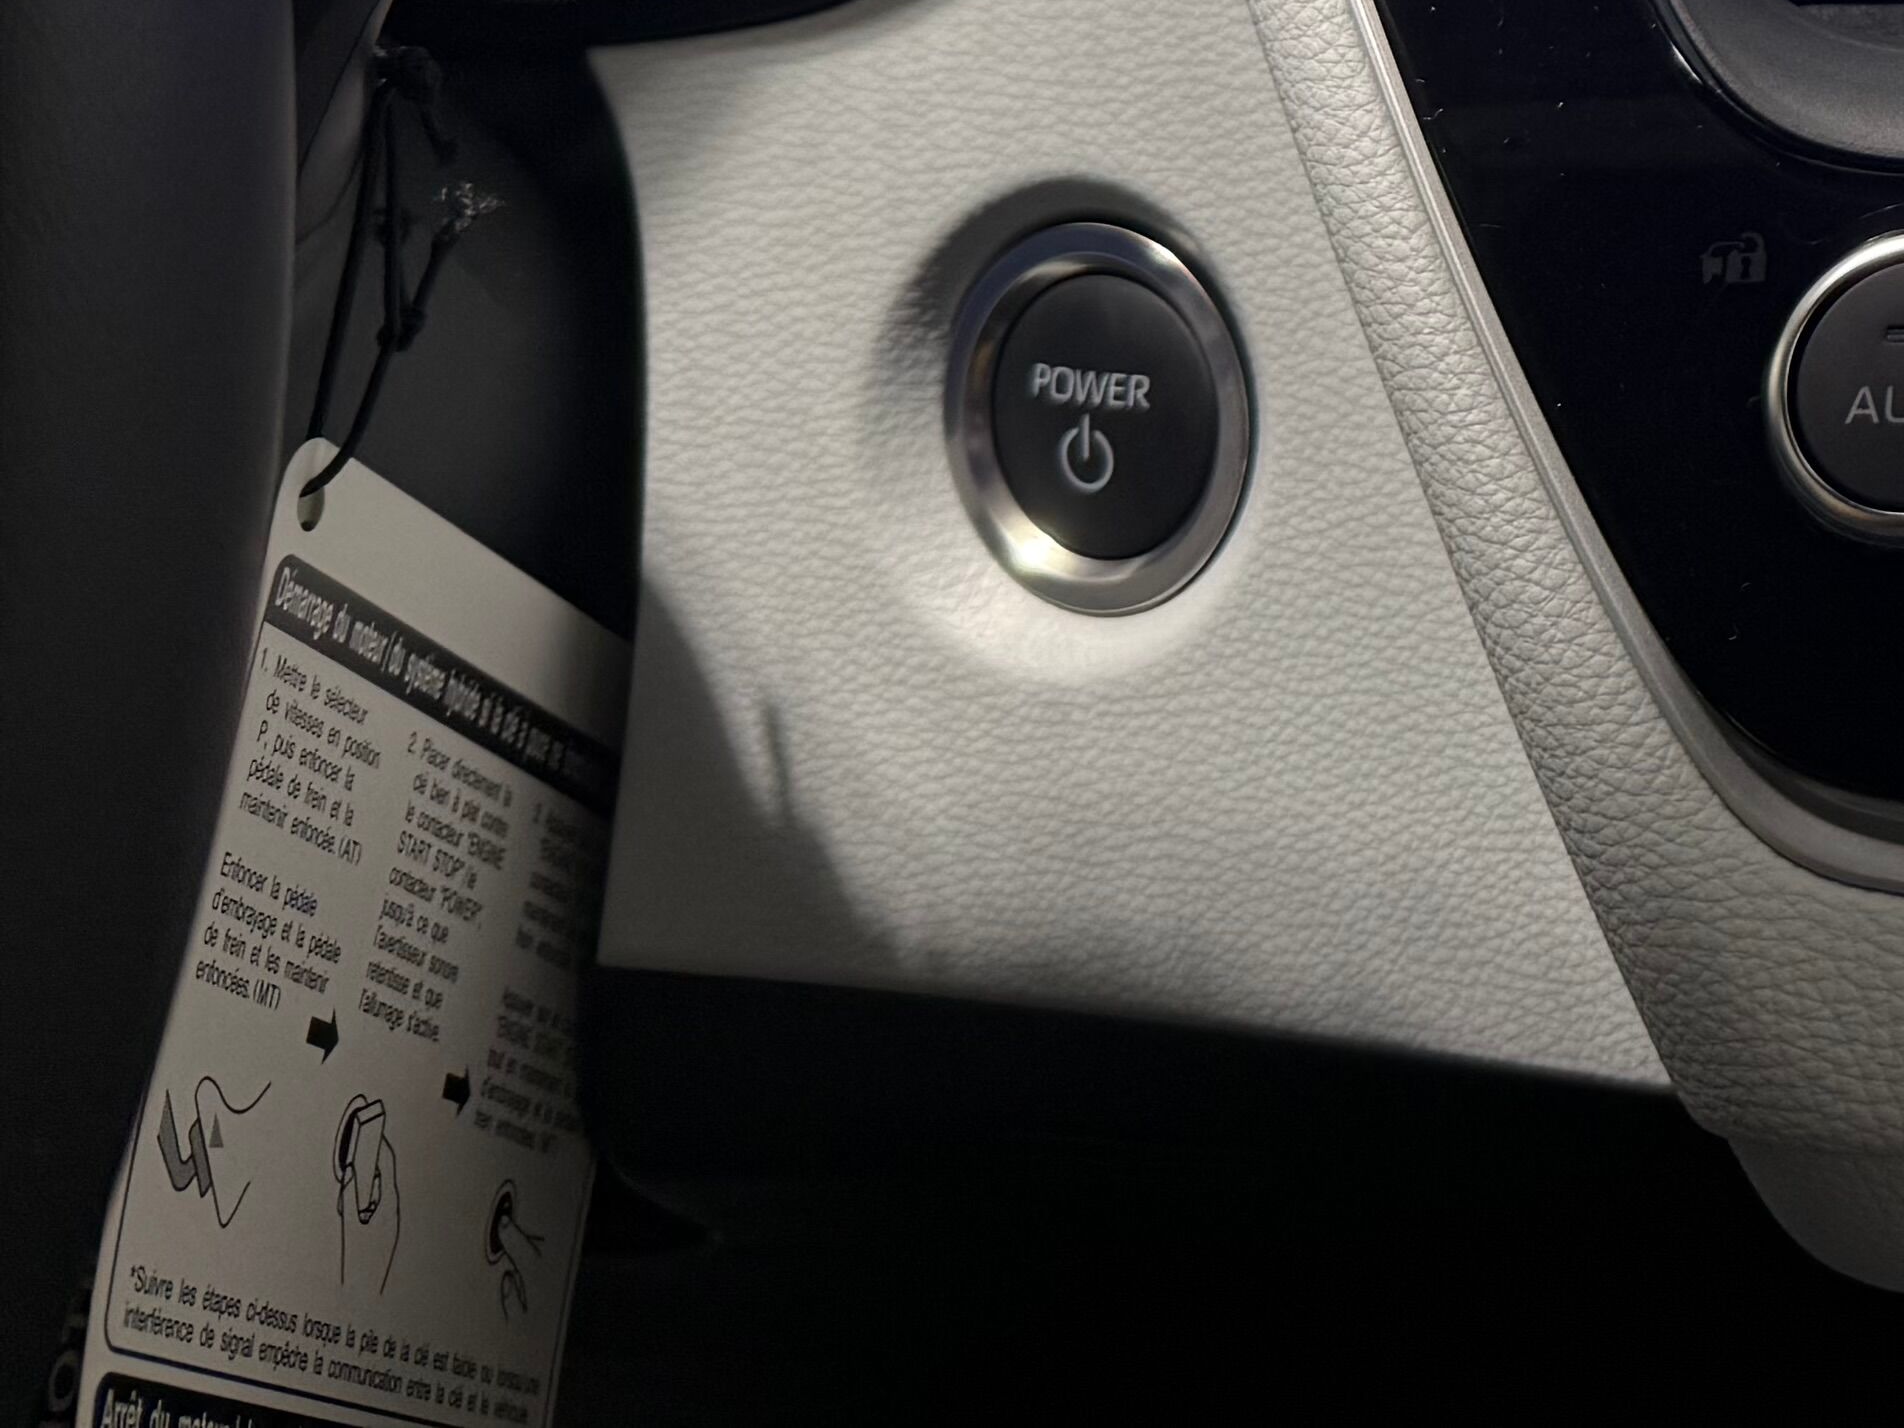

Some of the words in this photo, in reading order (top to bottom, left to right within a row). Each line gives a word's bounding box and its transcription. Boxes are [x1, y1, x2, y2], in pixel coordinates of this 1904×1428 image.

[1031, 361, 1150, 411] POWER
[276, 565, 333, 641] Démarrage
[333, 602, 352, 644] du
[260, 647, 269, 673] 1.
[273, 653, 308, 693] Mettre
[310, 674, 321, 701] le
[324, 685, 368, 726] sélecteur
[265, 688, 281, 715] de
[285, 699, 325, 739] vitesses
[327, 726, 342, 748] en
[342, 735, 380, 770] position
[270, 733, 297, 760] puis
[299, 747, 343, 784] enfoncer
[343, 764, 356, 793] la
[247, 755, 284, 791] pédale
[286, 773, 301, 800] de
[303, 780, 327, 813] frein
[329, 799, 343, 821] et
[342, 802, 355, 828] la
[239, 791, 289, 829] maintenir
[338, 833, 362, 867] (AT)
[397, 830, 433, 867] START
[219, 850, 268, 893] Enfoncer
[269, 874, 281, 901] la
[281, 884, 319, 919] pédale
[203, 921, 219, 948] de
[222, 927, 247, 960] frein
[249, 944, 263, 967] et
[264, 945, 281, 975] les
[284, 960, 331, 995] maintenir
[211, 887, 278, 940] d'embrayage
[280, 920, 294, 944] et
[294, 923, 306, 949] la
[306, 932, 342, 965] pédale
[416, 915, 430, 936] ce
[430, 922, 450, 946] que
[252, 979, 282, 1012] (MT)
[123, 1299, 195, 1344] interférence
[199, 1322, 216, 1350] de
[219, 1327, 256, 1361] signal
[258, 1341, 310, 1373] empêche
[312, 1350, 324, 1376] la
[327, 1358, 403, 1394] communication
[177, 1277, 199, 1308] les
[202, 1282, 242, 1323] étapes
[246, 1297, 299, 1335] ci-dessus
[302, 1311, 342, 1349] lorsque
[346, 1322, 356, 1349] la
[358, 1328, 379, 1358] pile
[383, 1335, 397, 1360] de
